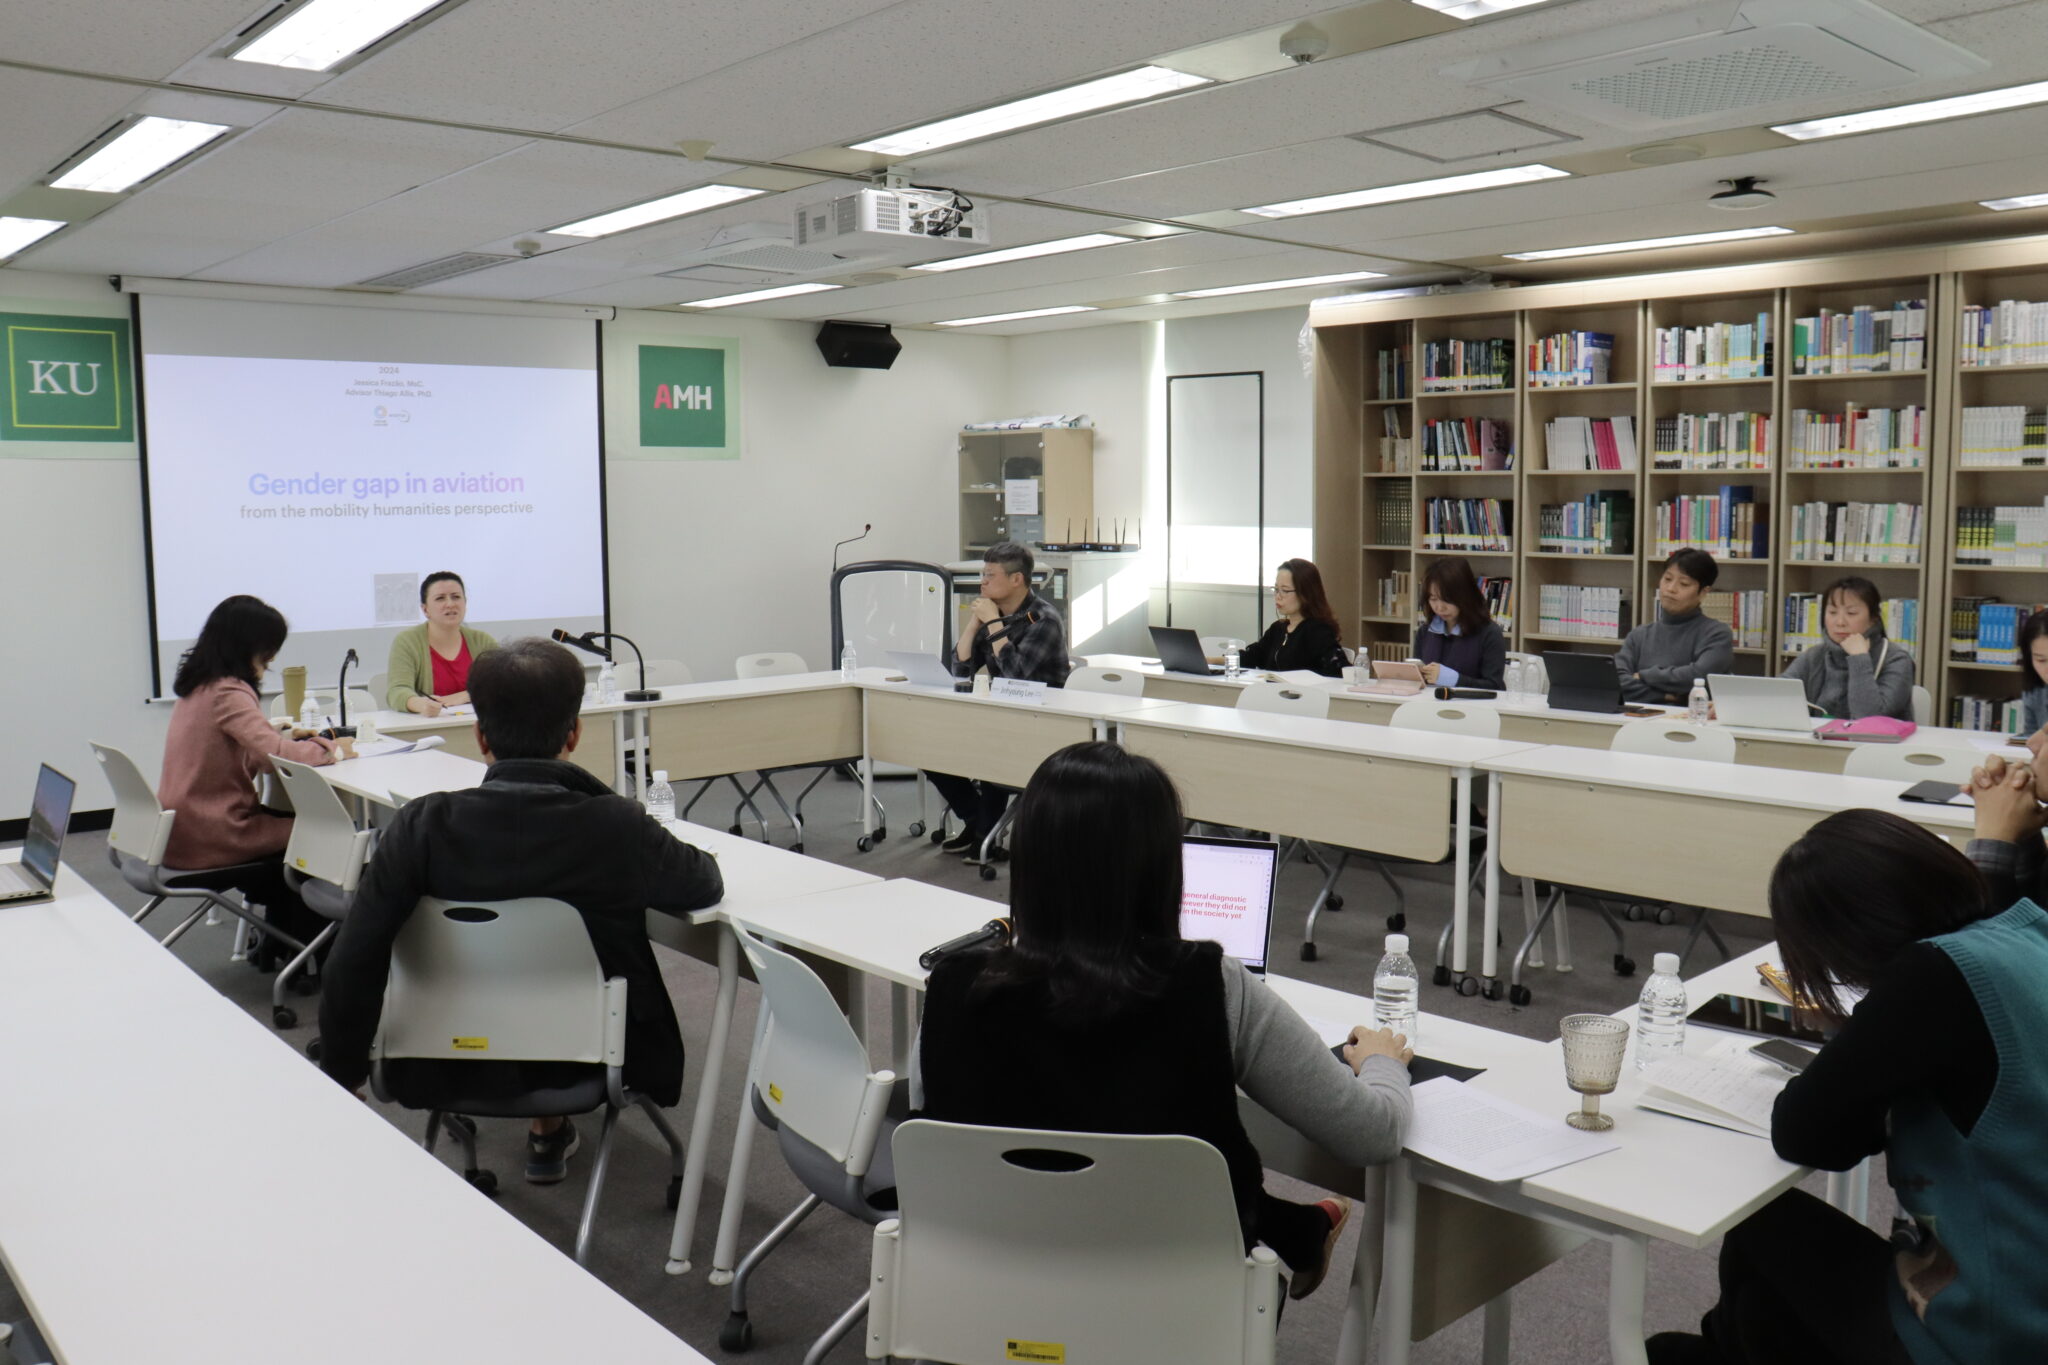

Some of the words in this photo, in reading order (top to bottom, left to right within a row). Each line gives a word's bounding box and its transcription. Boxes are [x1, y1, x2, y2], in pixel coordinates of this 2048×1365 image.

[379, 366, 400, 374] 2024
[27, 360, 101, 396] KU
[654, 384, 712, 410] AMH
[249, 472, 347, 496] Gender
[353, 477, 400, 500] gap
[406, 472, 427, 494] in
[432, 472, 525, 494] aviation
[240, 504, 277, 519] from
[281, 504, 306, 518] the
[310, 503, 369, 519] mobility
[374, 502, 451, 516] humanities
[454, 501, 534, 517] perspective
[1209, 893, 1247, 903] diagnostic
[1205, 901, 1221, 910] they
[1203, 911, 1229, 919] society
[1230, 912, 1242, 920] yet
